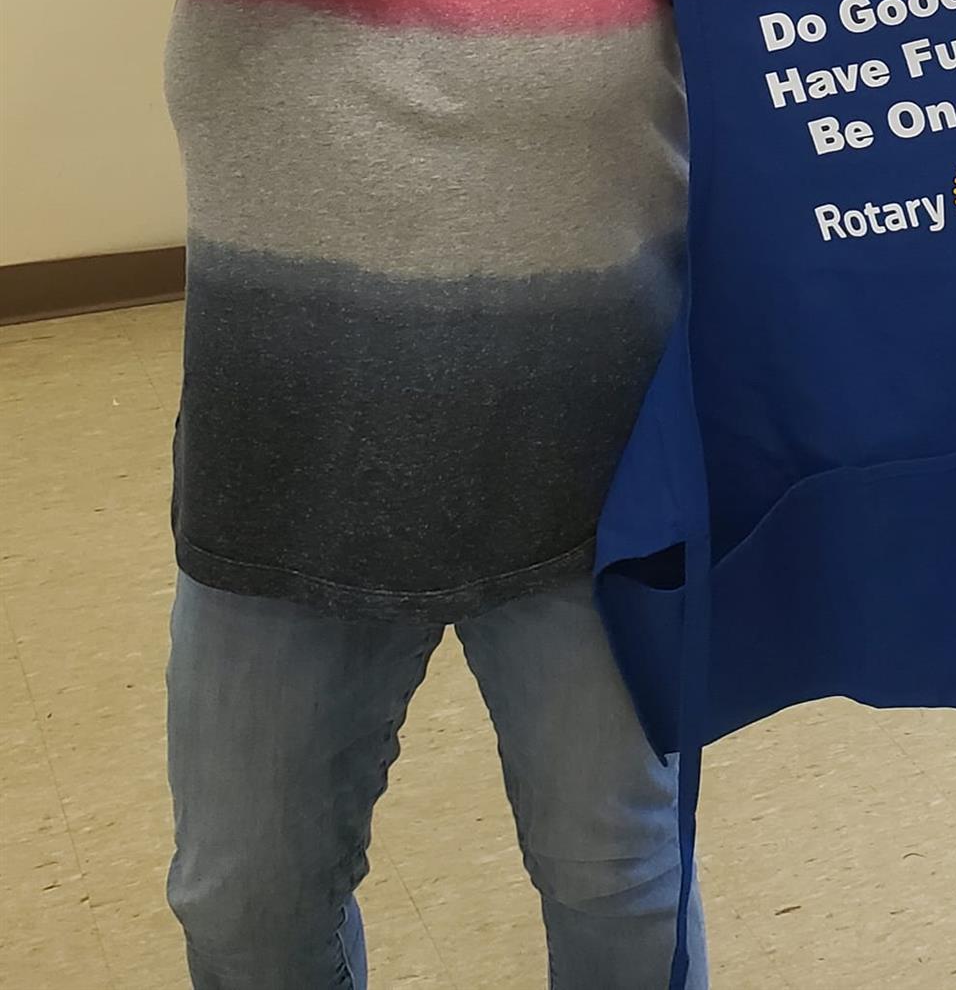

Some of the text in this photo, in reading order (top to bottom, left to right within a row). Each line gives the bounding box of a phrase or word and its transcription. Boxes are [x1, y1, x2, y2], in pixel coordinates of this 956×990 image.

[759, 12, 827, 52] Do
[765, 59, 890, 109] Have
[807, 116, 875, 156] Be
[814, 194, 944, 241] Rotary
